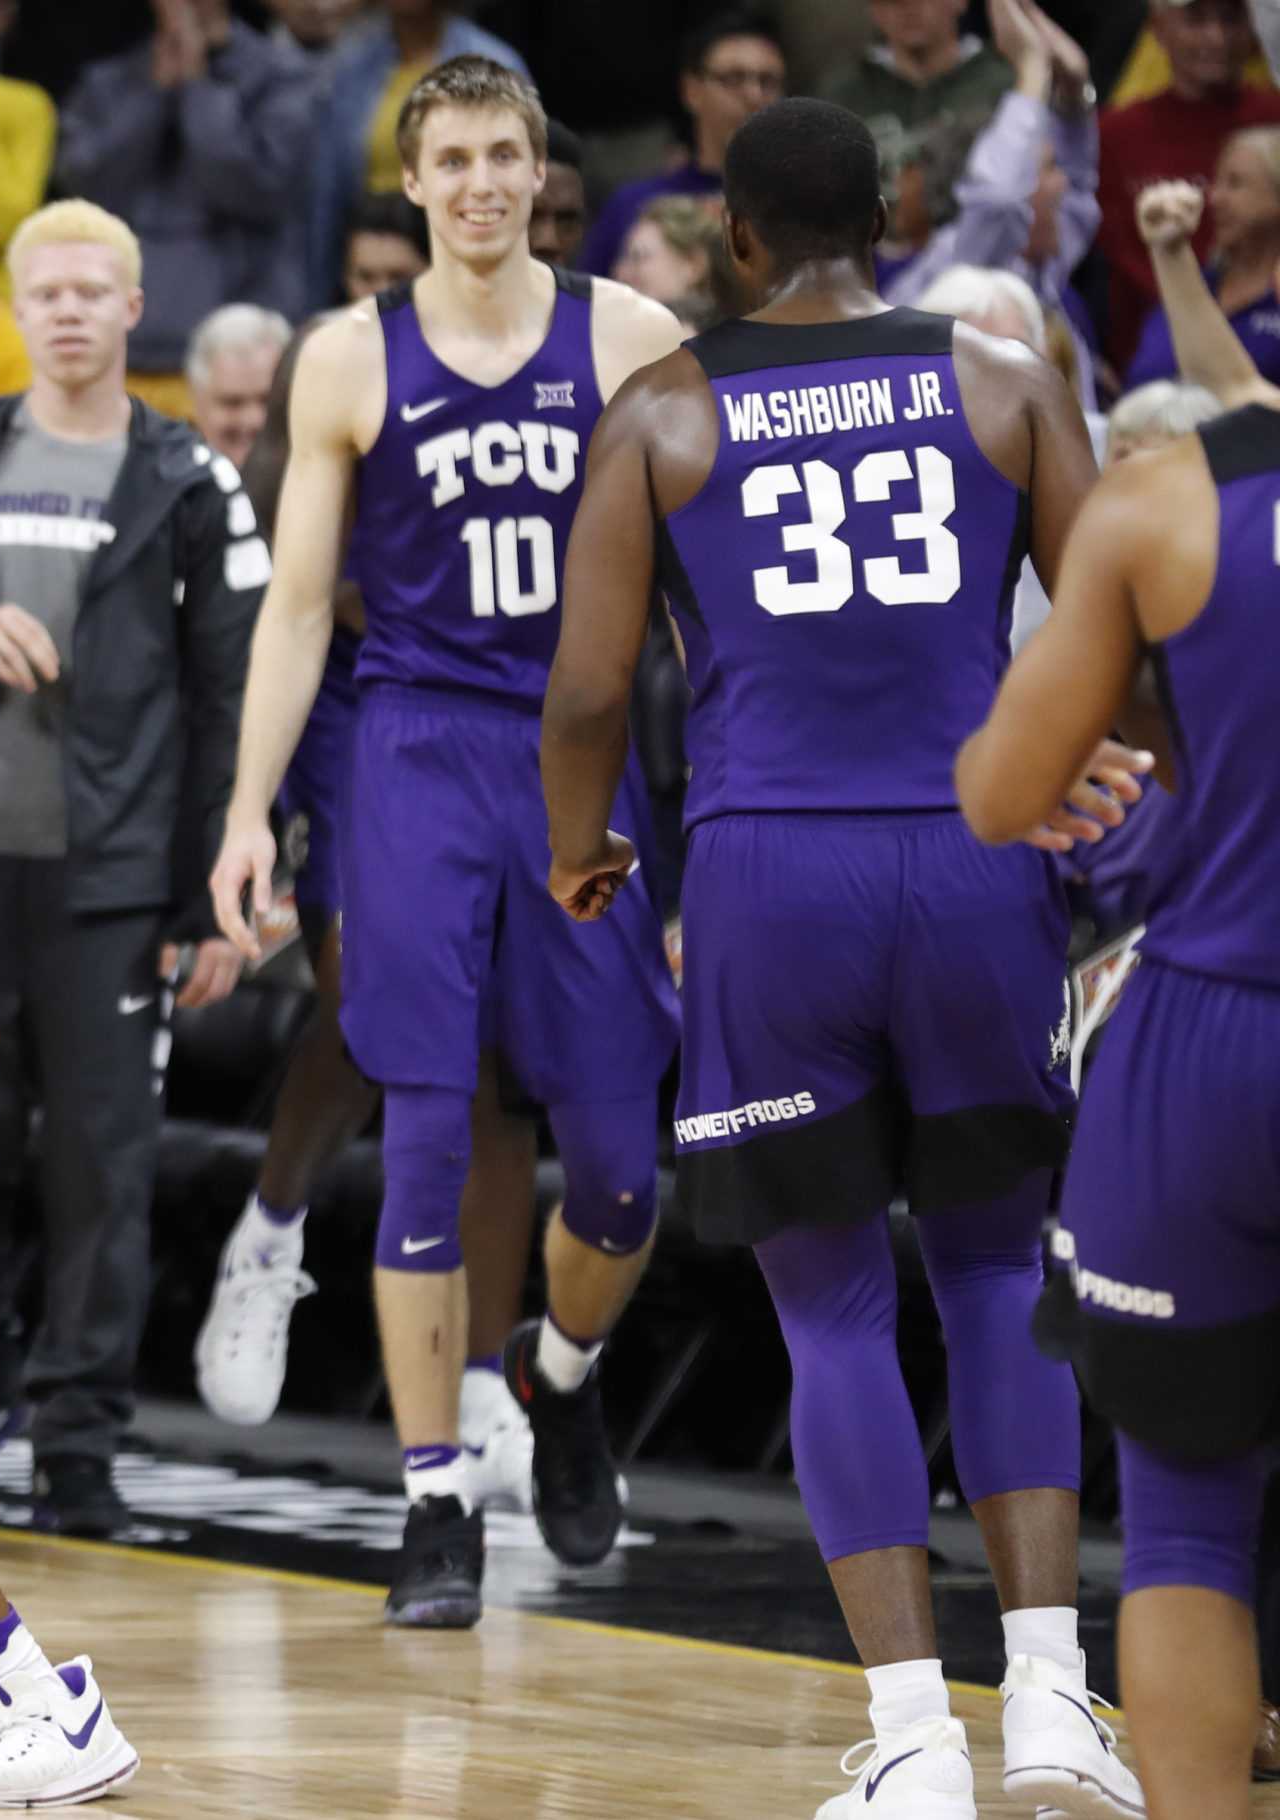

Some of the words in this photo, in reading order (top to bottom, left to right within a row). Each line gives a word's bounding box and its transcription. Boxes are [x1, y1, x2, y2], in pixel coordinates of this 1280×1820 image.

[723, 377, 896, 442] WASHBURN
[903, 370, 955, 422] JR.
[415, 420, 581, 509] TCU
[459, 515, 558, 619] 10
[741, 445, 961, 616] 33
[728, 1090, 817, 1134] FROGS
